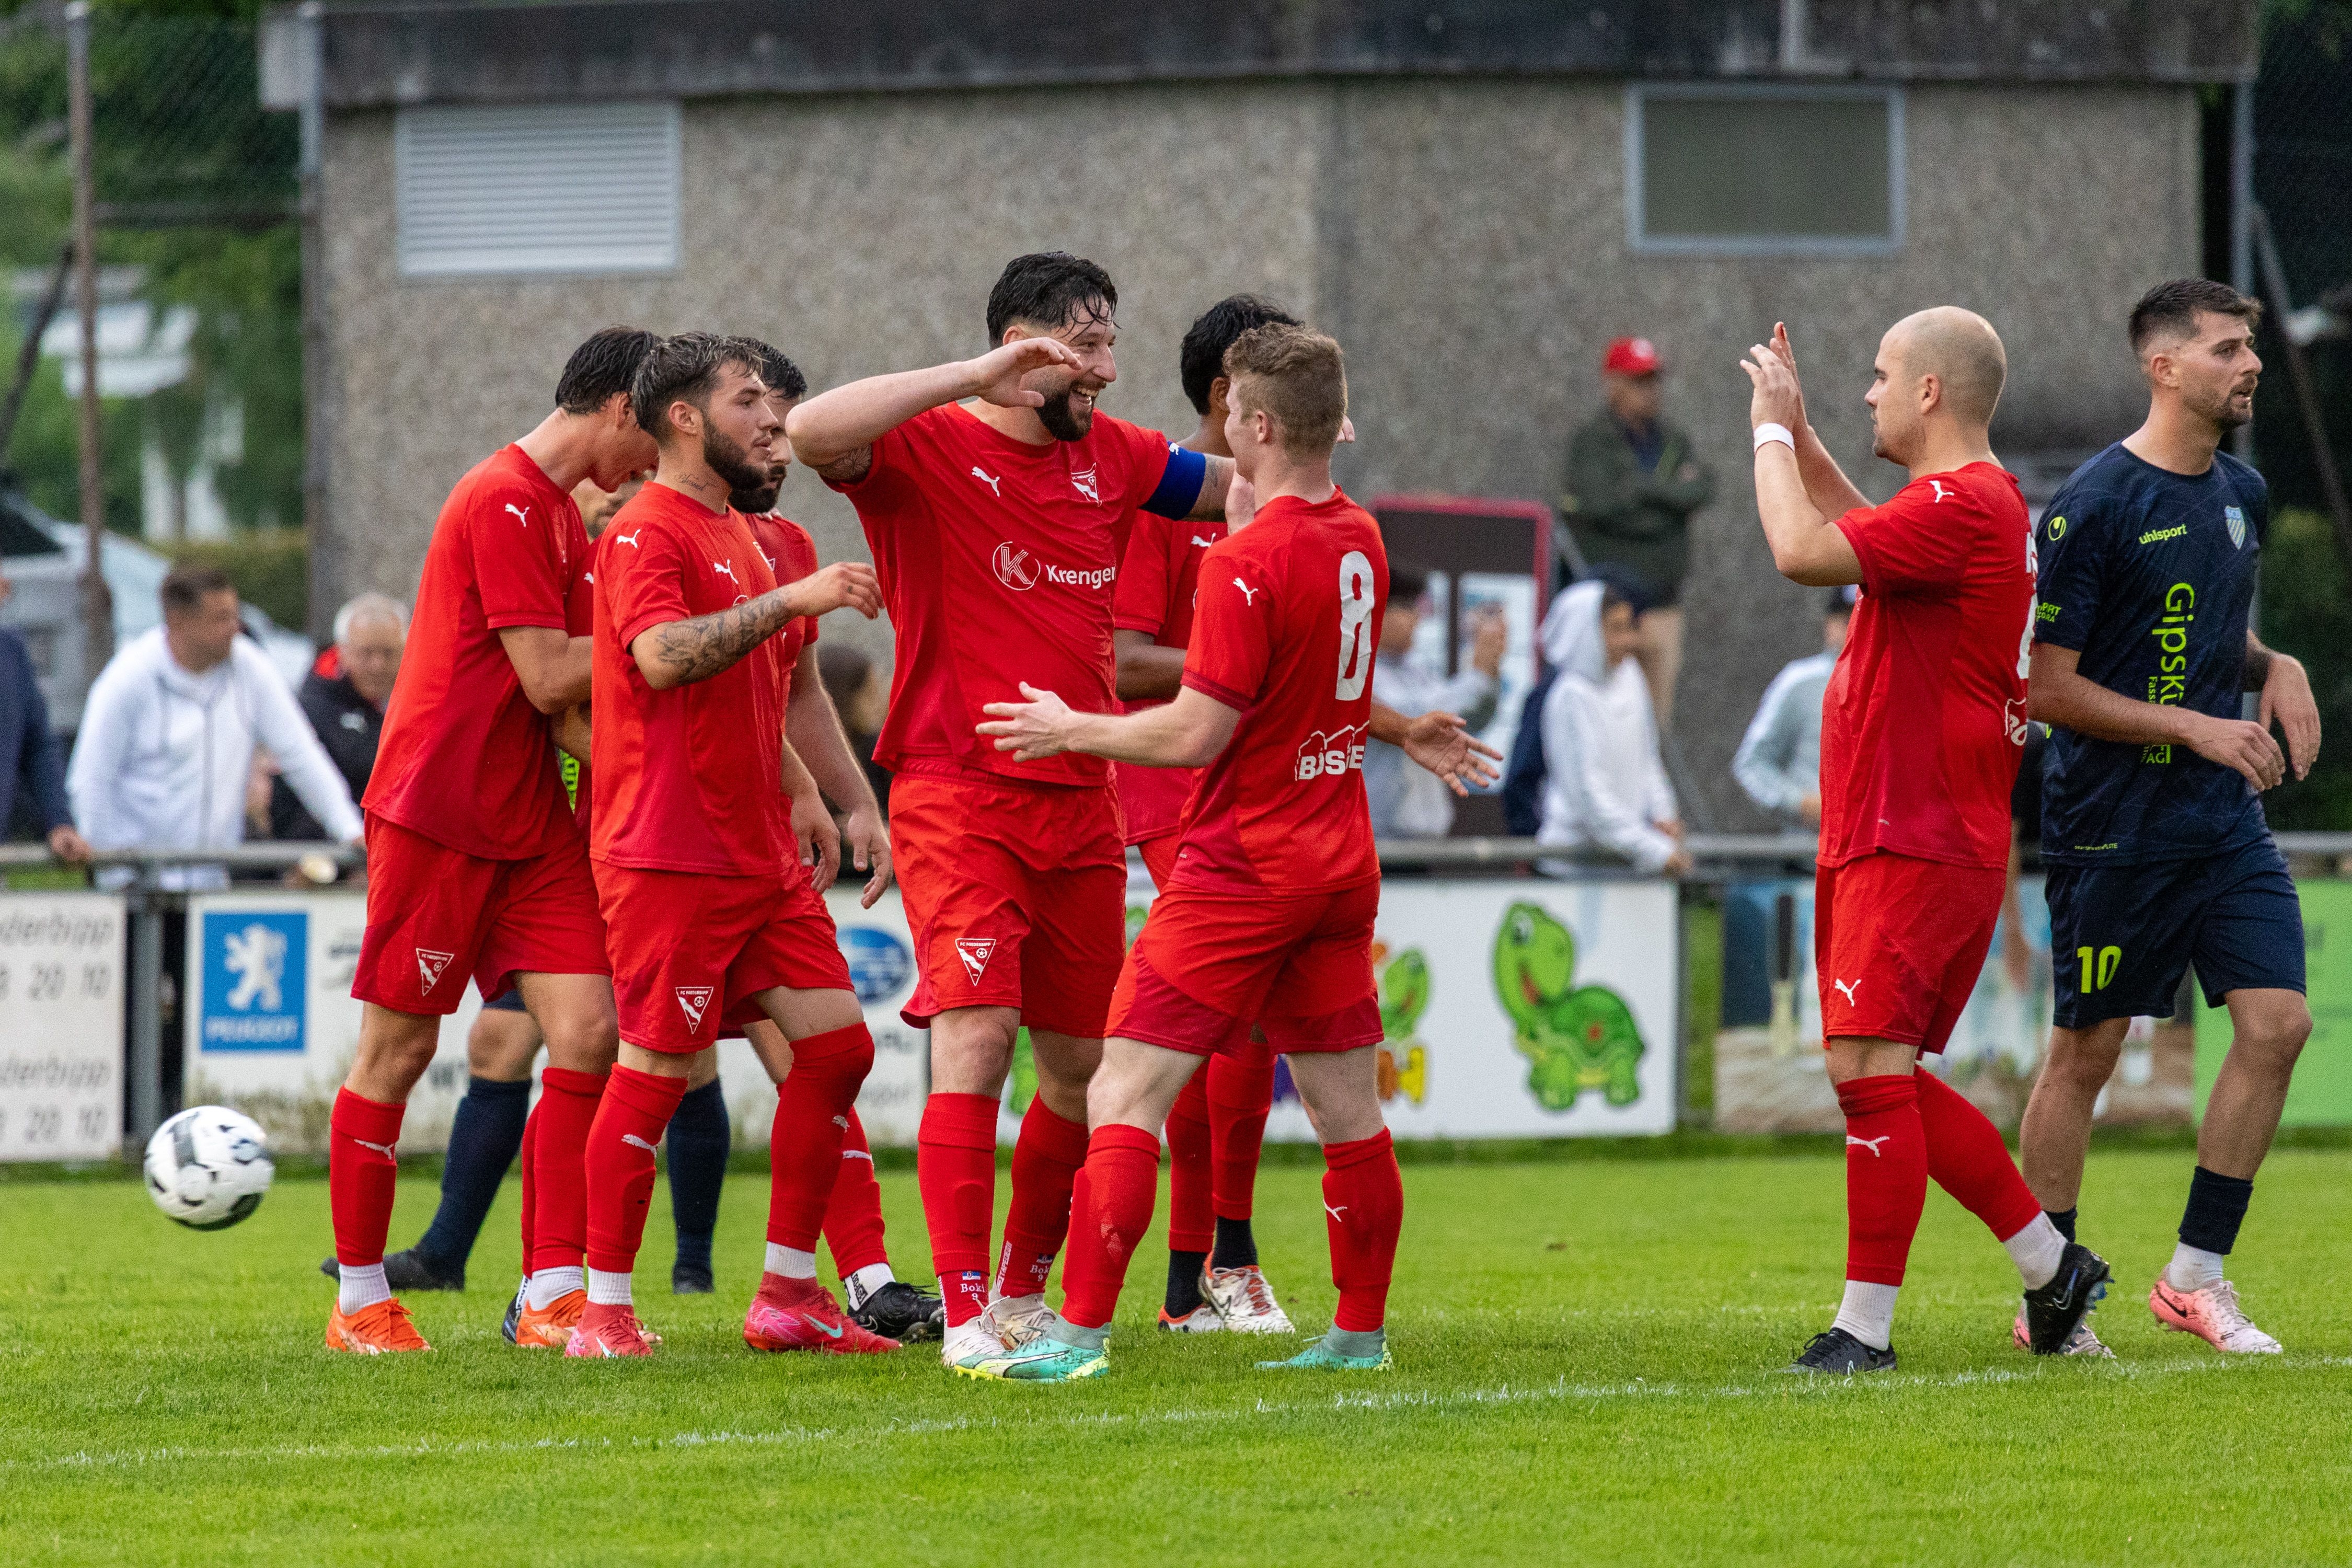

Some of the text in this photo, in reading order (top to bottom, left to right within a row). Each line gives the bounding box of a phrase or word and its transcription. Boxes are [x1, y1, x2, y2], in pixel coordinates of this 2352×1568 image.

[2138, 524, 2187, 545] uhlsport
[1045, 564, 1116, 590] Krenger
[1335, 550, 1375, 701] 8
[2077, 945, 2122, 993] 10
[960, 1283, 985, 1294] Boki
[1037, 1274, 1044, 1282] 9
